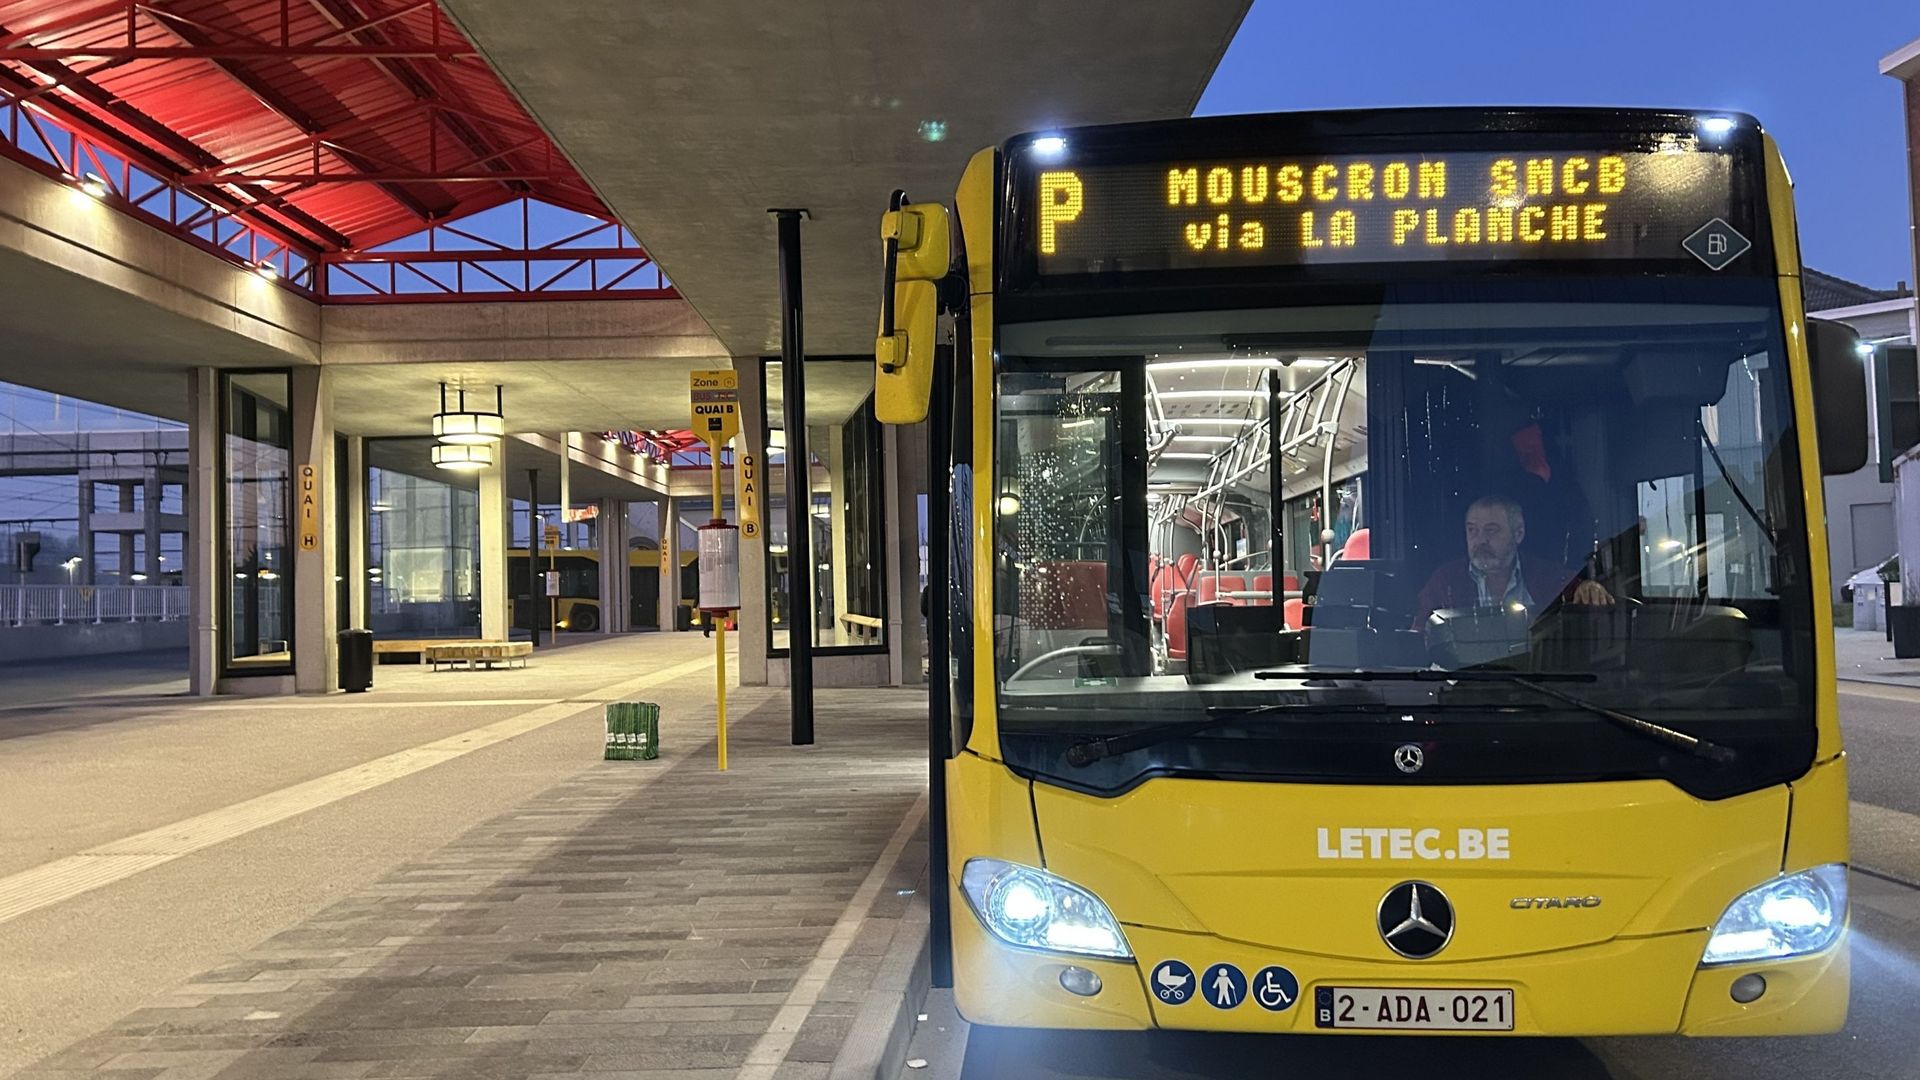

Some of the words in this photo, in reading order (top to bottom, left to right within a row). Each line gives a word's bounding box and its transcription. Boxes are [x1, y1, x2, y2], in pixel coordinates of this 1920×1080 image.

[1167, 161, 1447, 205] MOUSCRON
[1039, 171, 1084, 255] P
[1185, 212, 1265, 250] via
[1300, 209, 1356, 248] LA
[1393, 203, 1608, 246] PLANCHE
[693, 378, 719, 387] Zone
[695, 404, 724, 415] QUAI
[726, 404, 734, 414] B
[302, 467, 313, 519] QUAI
[743, 456, 754, 507] QUAI
[1316, 827, 1511, 860] LETEC.BE
[1509, 895, 1602, 910] CITARO
[1319, 1009, 1331, 1022] B
[1338, 994, 1505, 1023] 2-ADA-021
